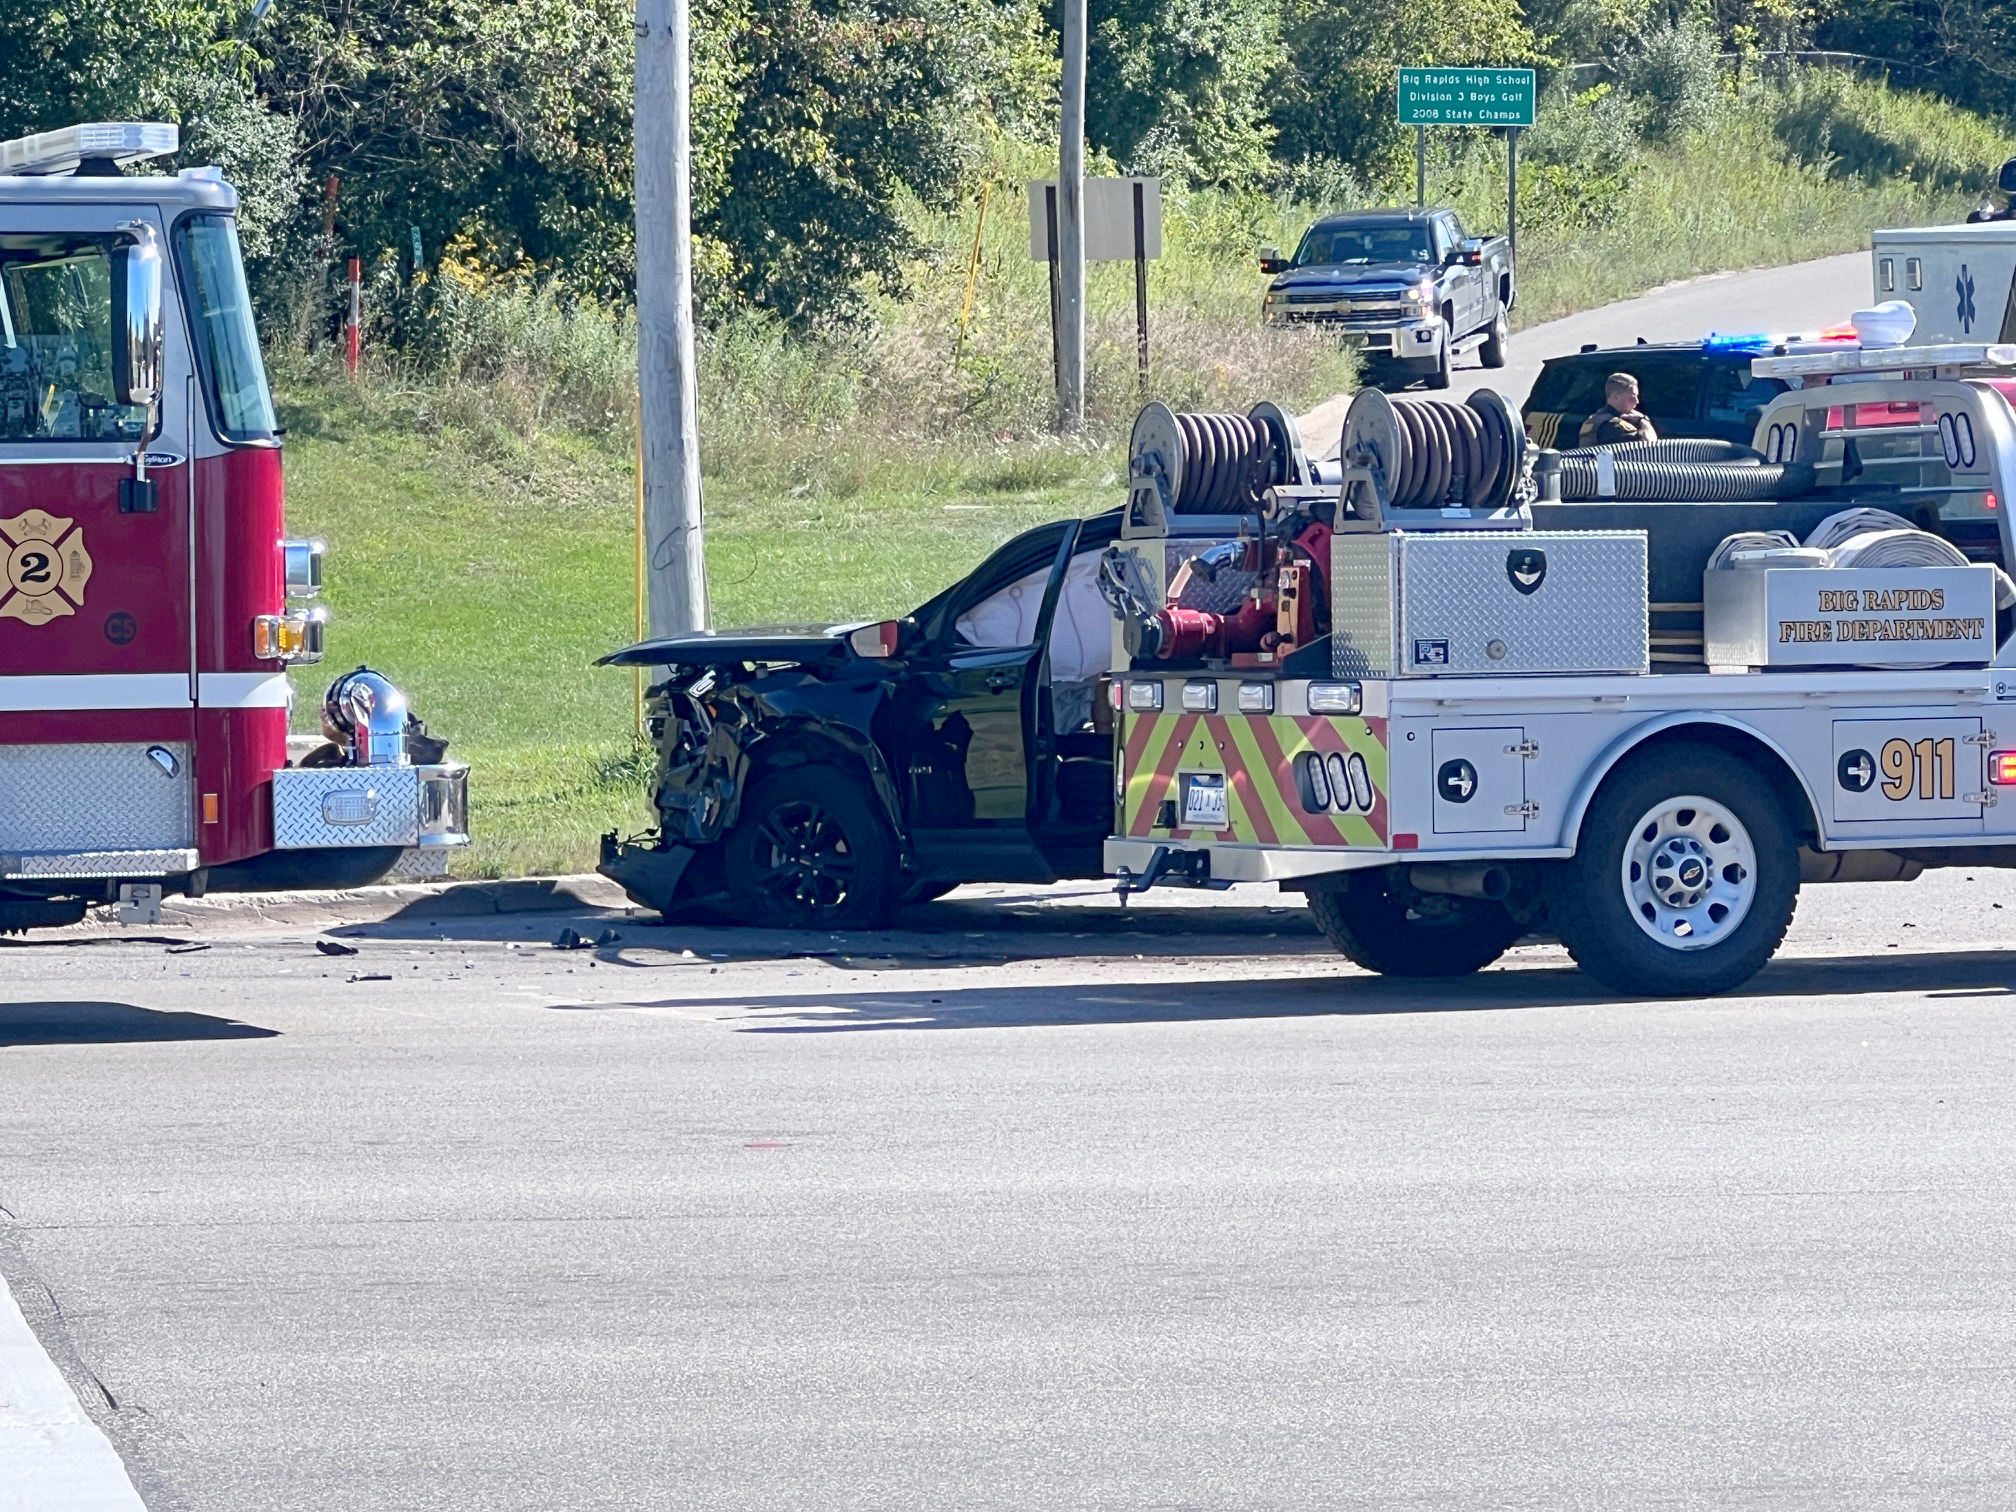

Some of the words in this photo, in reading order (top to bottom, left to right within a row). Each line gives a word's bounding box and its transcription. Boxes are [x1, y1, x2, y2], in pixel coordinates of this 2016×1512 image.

[1402, 74, 1420, 86] Big
[1425, 74, 1460, 86] Rapids
[1466, 75, 1490, 87] High
[1496, 75, 1530, 85] School
[1410, 92, 1452, 101] Division
[1457, 92, 1465, 101] 3
[1470, 92, 1496, 103] Boys
[1501, 92, 1523, 102] Golf
[1412, 109, 1439, 119] 2008
[1445, 109, 1473, 119] State
[1479, 109, 1521, 120] Champs
[20, 552, 51, 583] 2
[1819, 590, 1859, 612] BIG
[1862, 589, 1944, 611] RAPIDS
[1779, 621, 1832, 642] FIRE
[1837, 618, 1984, 641] DEPARTMENT
[1881, 737, 1955, 801] 911
